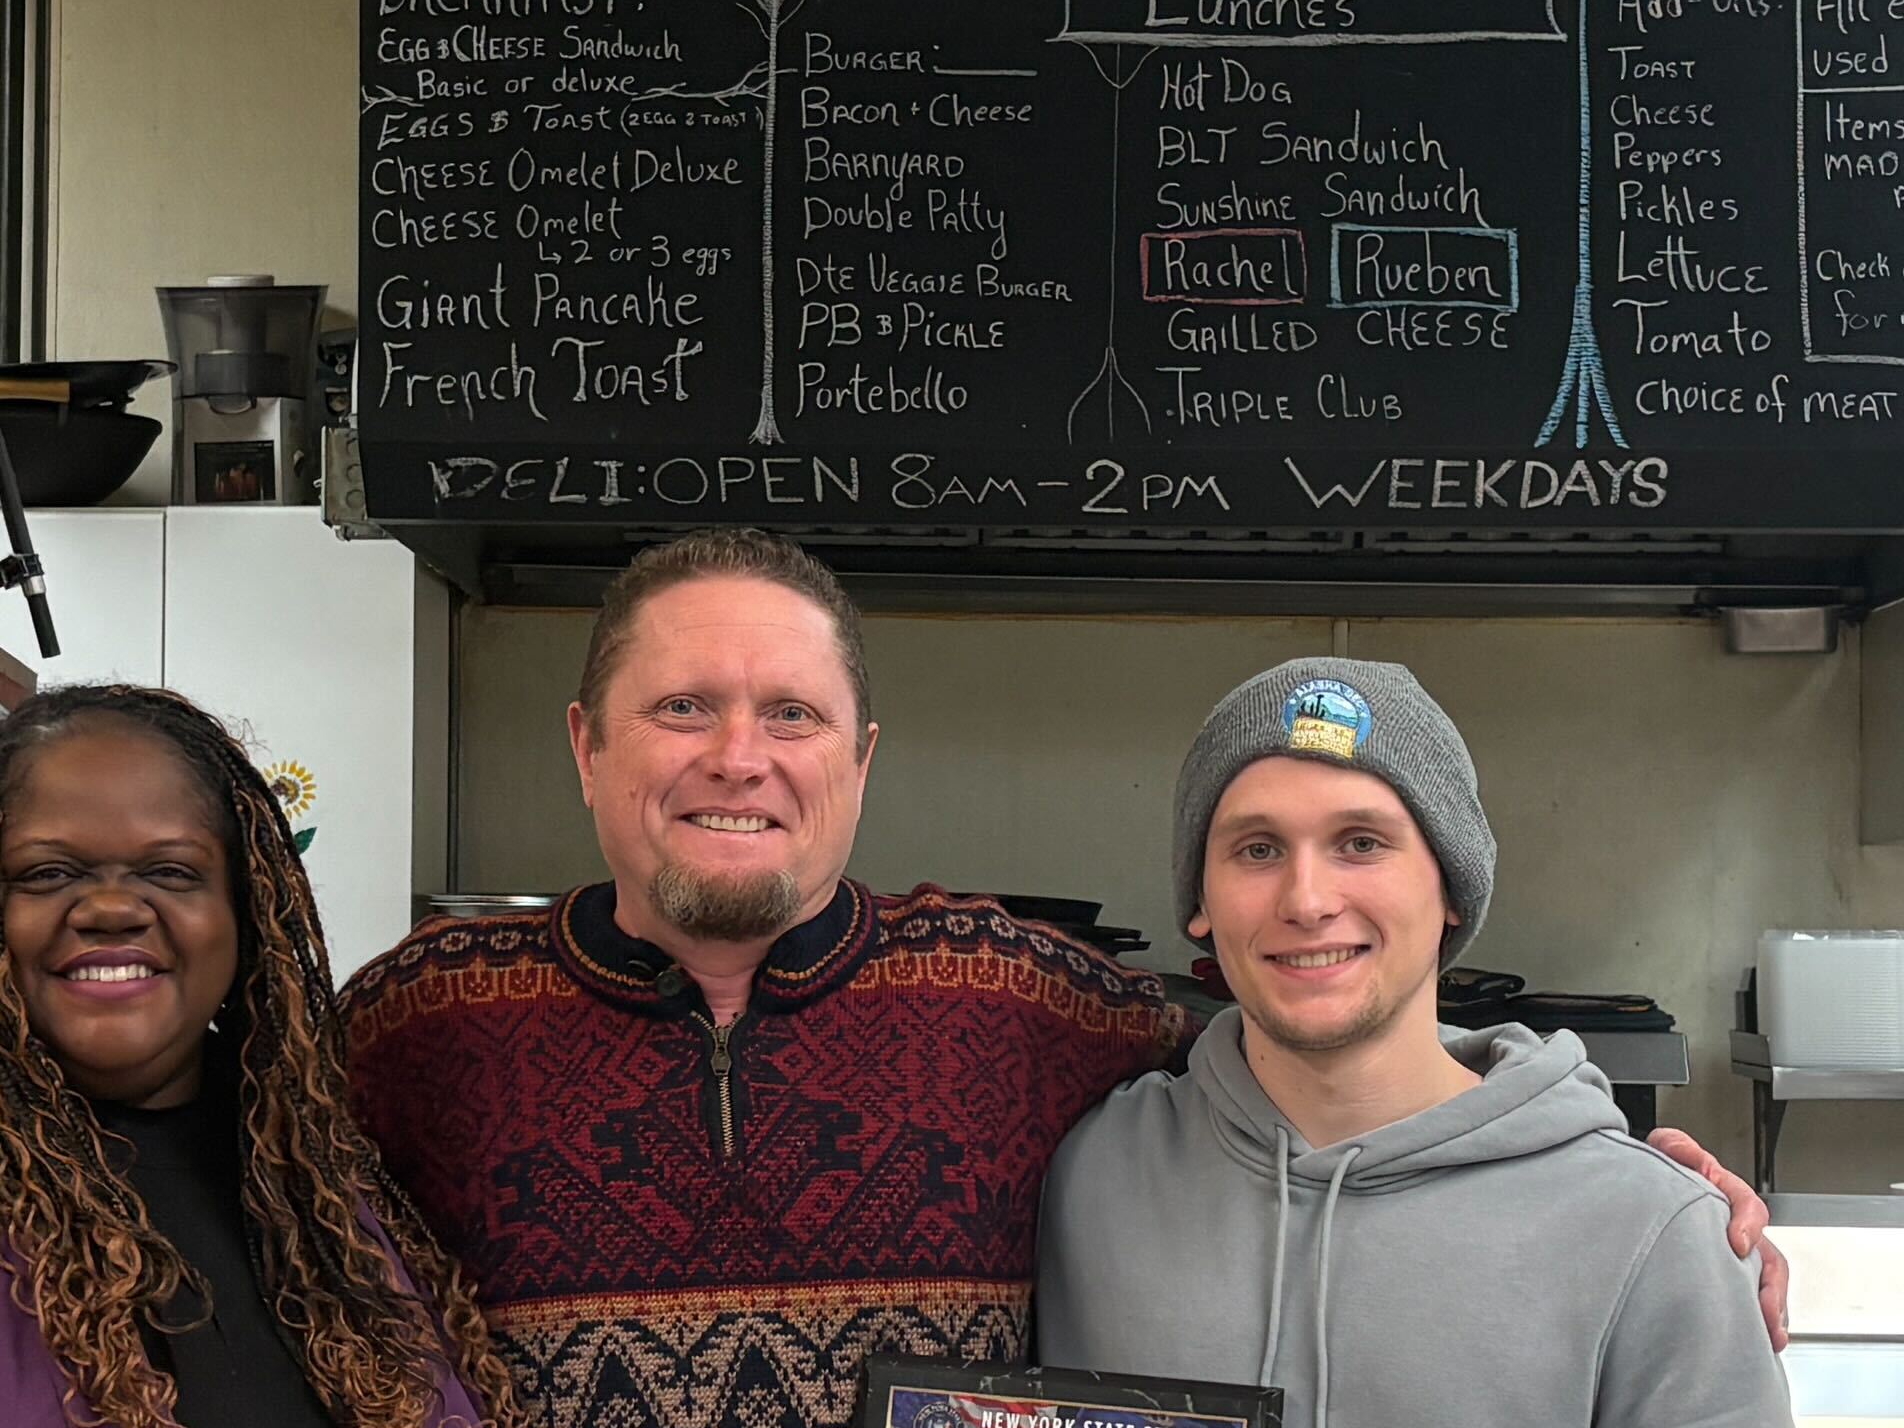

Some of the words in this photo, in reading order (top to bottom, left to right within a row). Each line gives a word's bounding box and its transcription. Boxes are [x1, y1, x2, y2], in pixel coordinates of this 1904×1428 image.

[1814, 34, 1888, 76] used
[417, 69, 488, 101] Basic
[506, 76, 533, 93] or
[553, 67, 639, 96] deluxe
[801, 86, 900, 129] Bacon
[929, 93, 1033, 127] Cheese
[1161, 60, 1212, 111] Hot
[1222, 58, 1292, 104] Dog
[1610, 93, 1715, 126] Cheese
[1158, 125, 1237, 169] BLT
[1260, 109, 1449, 171] Sandwich
[1613, 131, 1722, 174] Peppers
[508, 147, 621, 193] Omelet
[630, 145, 743, 193] Deluxe
[516, 196, 623, 240] Omelet
[1320, 167, 1490, 229] Sandwich
[1618, 180, 1738, 227] Pickles
[803, 192, 913, 240] Double
[927, 188, 1006, 260] Patty
[570, 239, 594, 264] 2
[609, 246, 642, 264] or
[651, 234, 671, 267] 3
[682, 246, 732, 276] eggs
[1164, 237, 1298, 295] Rachel
[1816, 249, 1890, 280] Check
[798, 302, 863, 350] PB
[1612, 298, 1771, 358] Tomato
[1833, 288, 1888, 337] for
[379, 341, 549, 421] French
[796, 363, 967, 418] Portebello
[1756, 374, 1789, 423] of
[1803, 391, 1898, 423] MEAT
[652, 456, 859, 505] OPEN
[1283, 456, 1669, 509] WEEKDAYS
